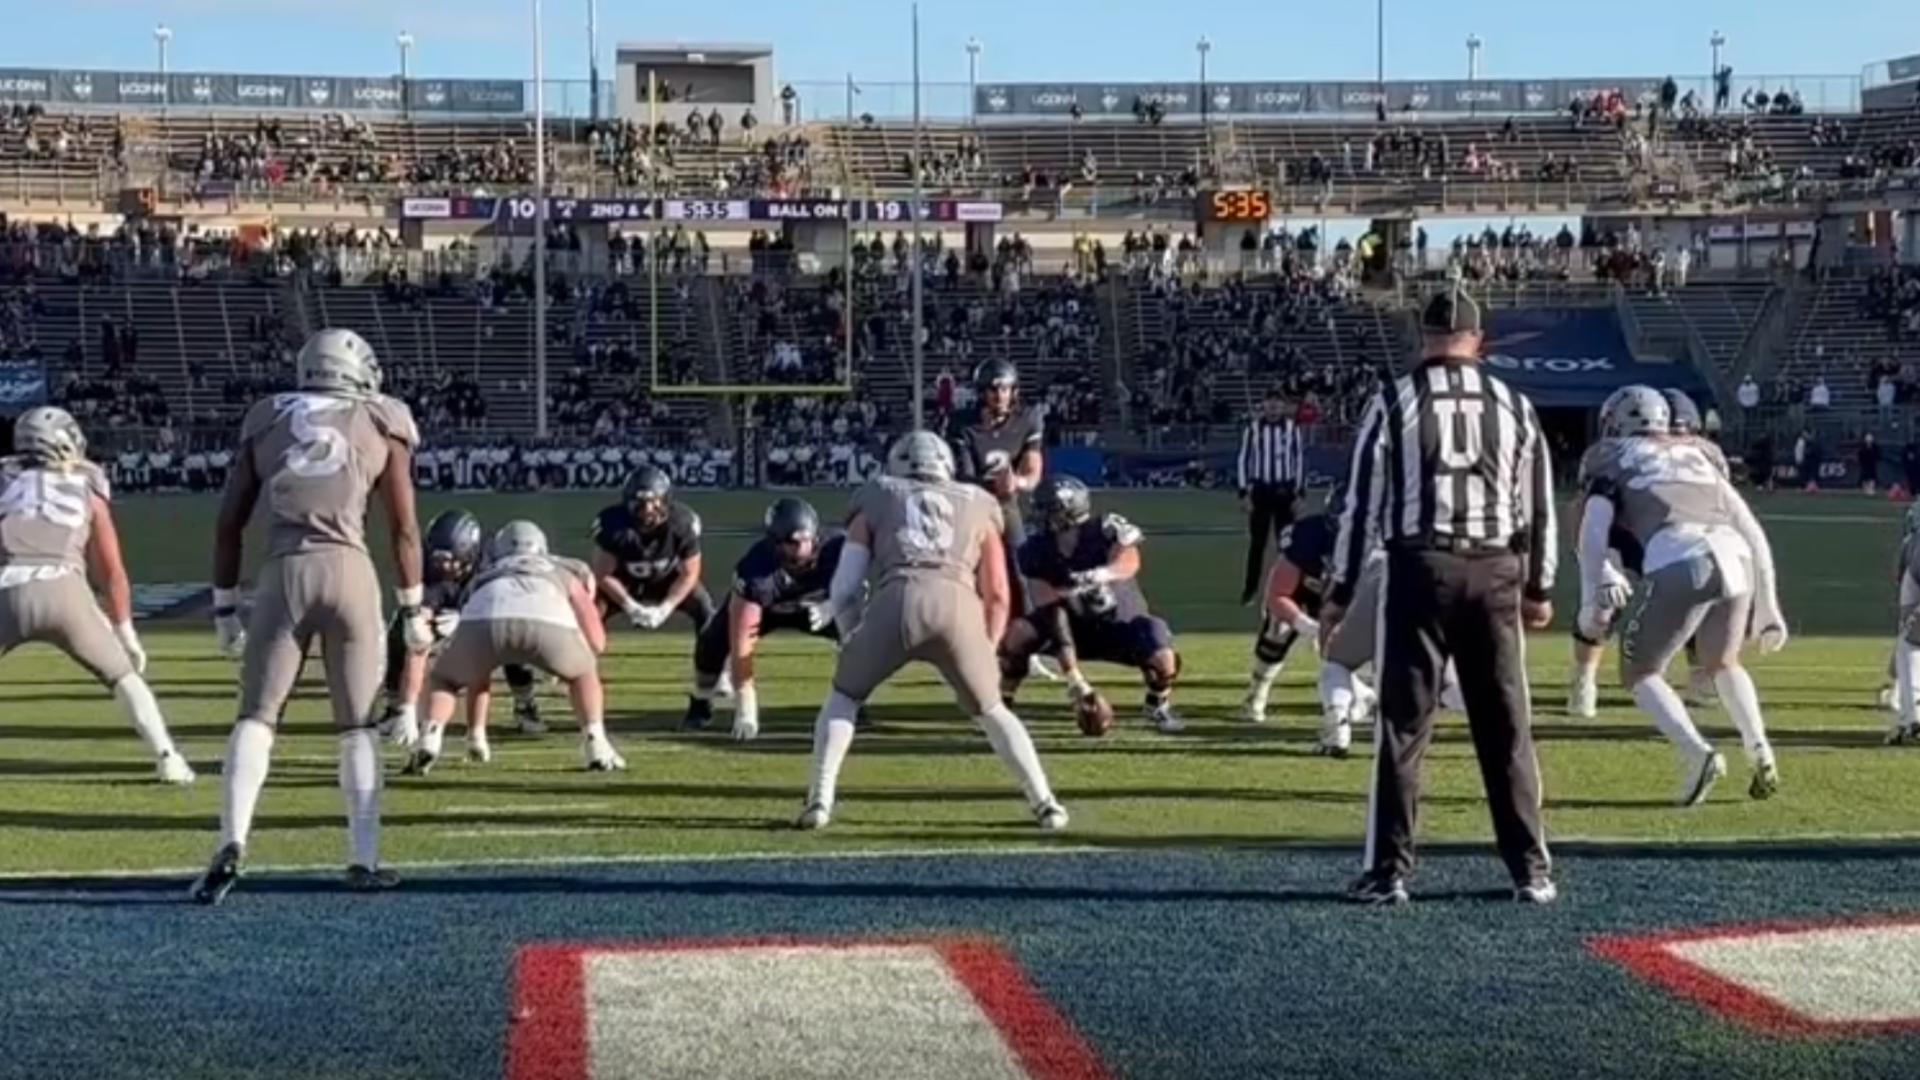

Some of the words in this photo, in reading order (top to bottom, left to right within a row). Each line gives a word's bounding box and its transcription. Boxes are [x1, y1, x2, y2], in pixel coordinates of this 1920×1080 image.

[509, 199, 535, 218] 10
[591, 202, 624, 217] 2ND
[682, 202, 729, 217] 5:35
[769, 203, 810, 217] BALL
[813, 203, 838, 217] ON
[875, 201, 900, 219] 19
[1214, 192, 1267, 217] 5:35
[1483, 354, 1616, 372] erox
[286, 396, 353, 477] 5
[1433, 398, 1484, 469] U
[983, 450, 1009, 480] 2
[0, 470, 85, 528] 45
